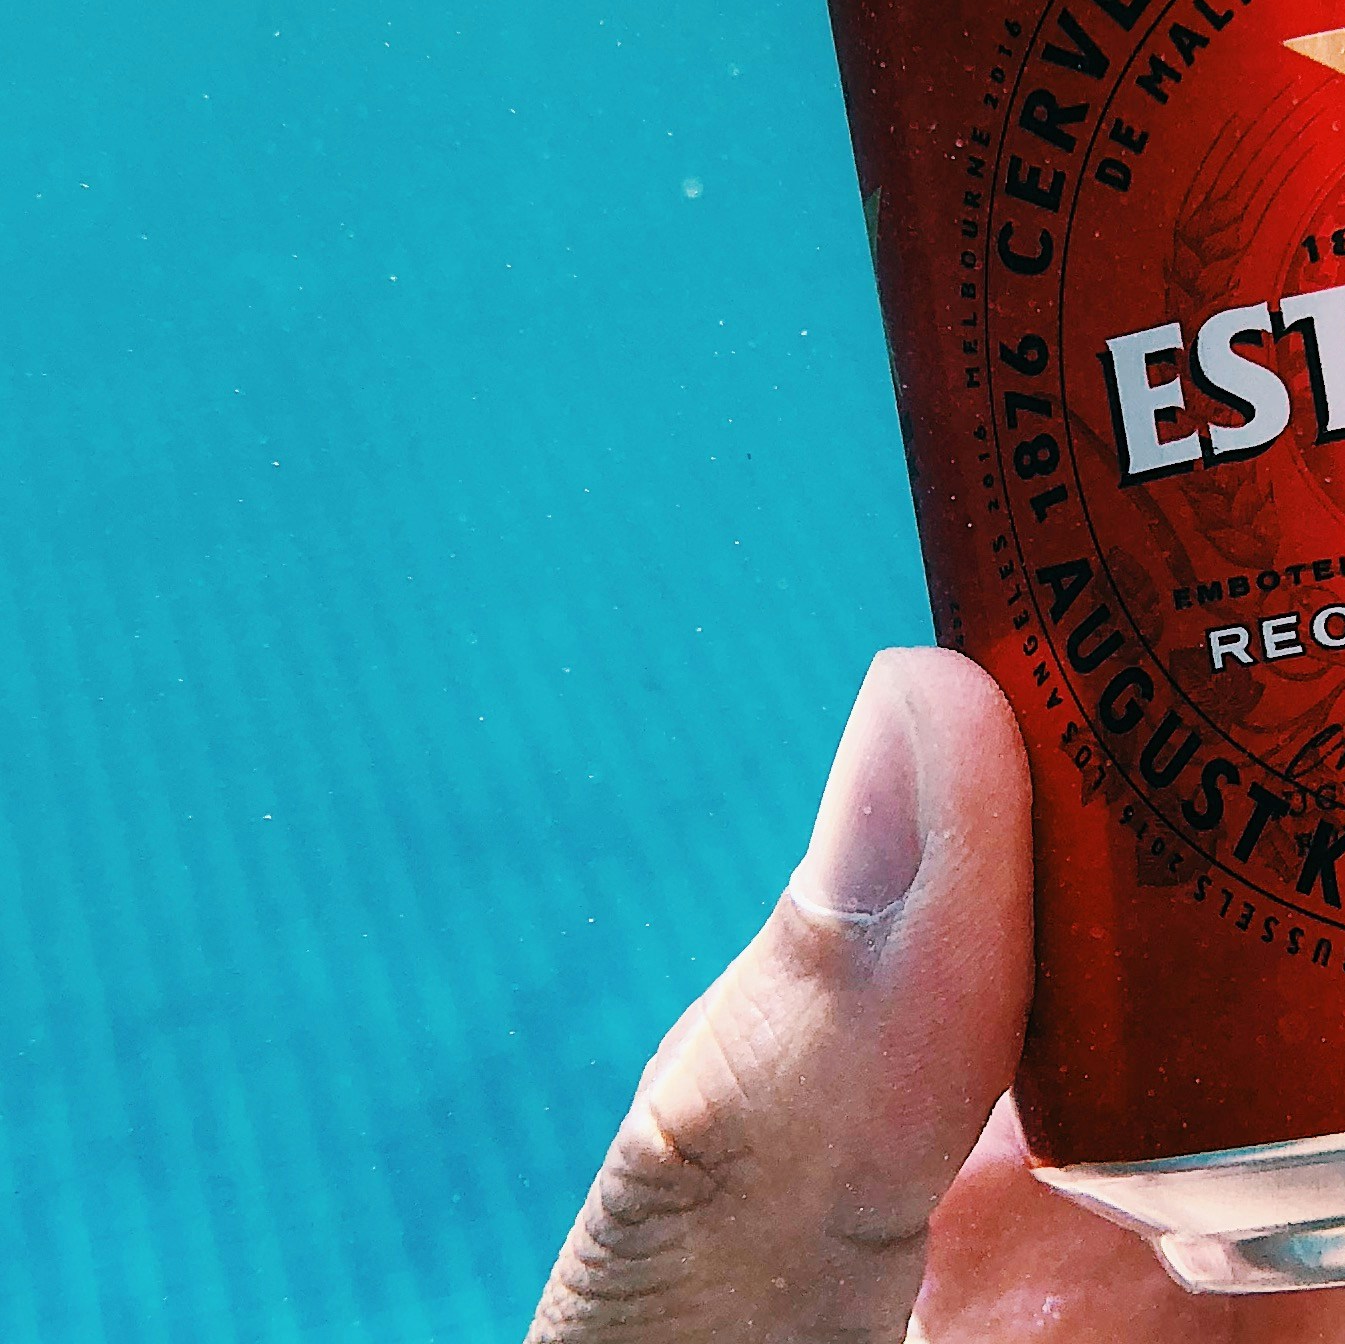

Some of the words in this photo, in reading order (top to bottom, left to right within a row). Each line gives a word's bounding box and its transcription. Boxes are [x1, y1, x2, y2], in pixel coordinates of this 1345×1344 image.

[959, 126, 992, 389] MELBOURNE
[983, 18, 1024, 111] 2016
[1096, 117, 1149, 193] DE
[1000, 332, 1068, 524] 1876
[992, 534, 1063, 710] ANGELES
[1035, 557, 1292, 864] AUGUST
